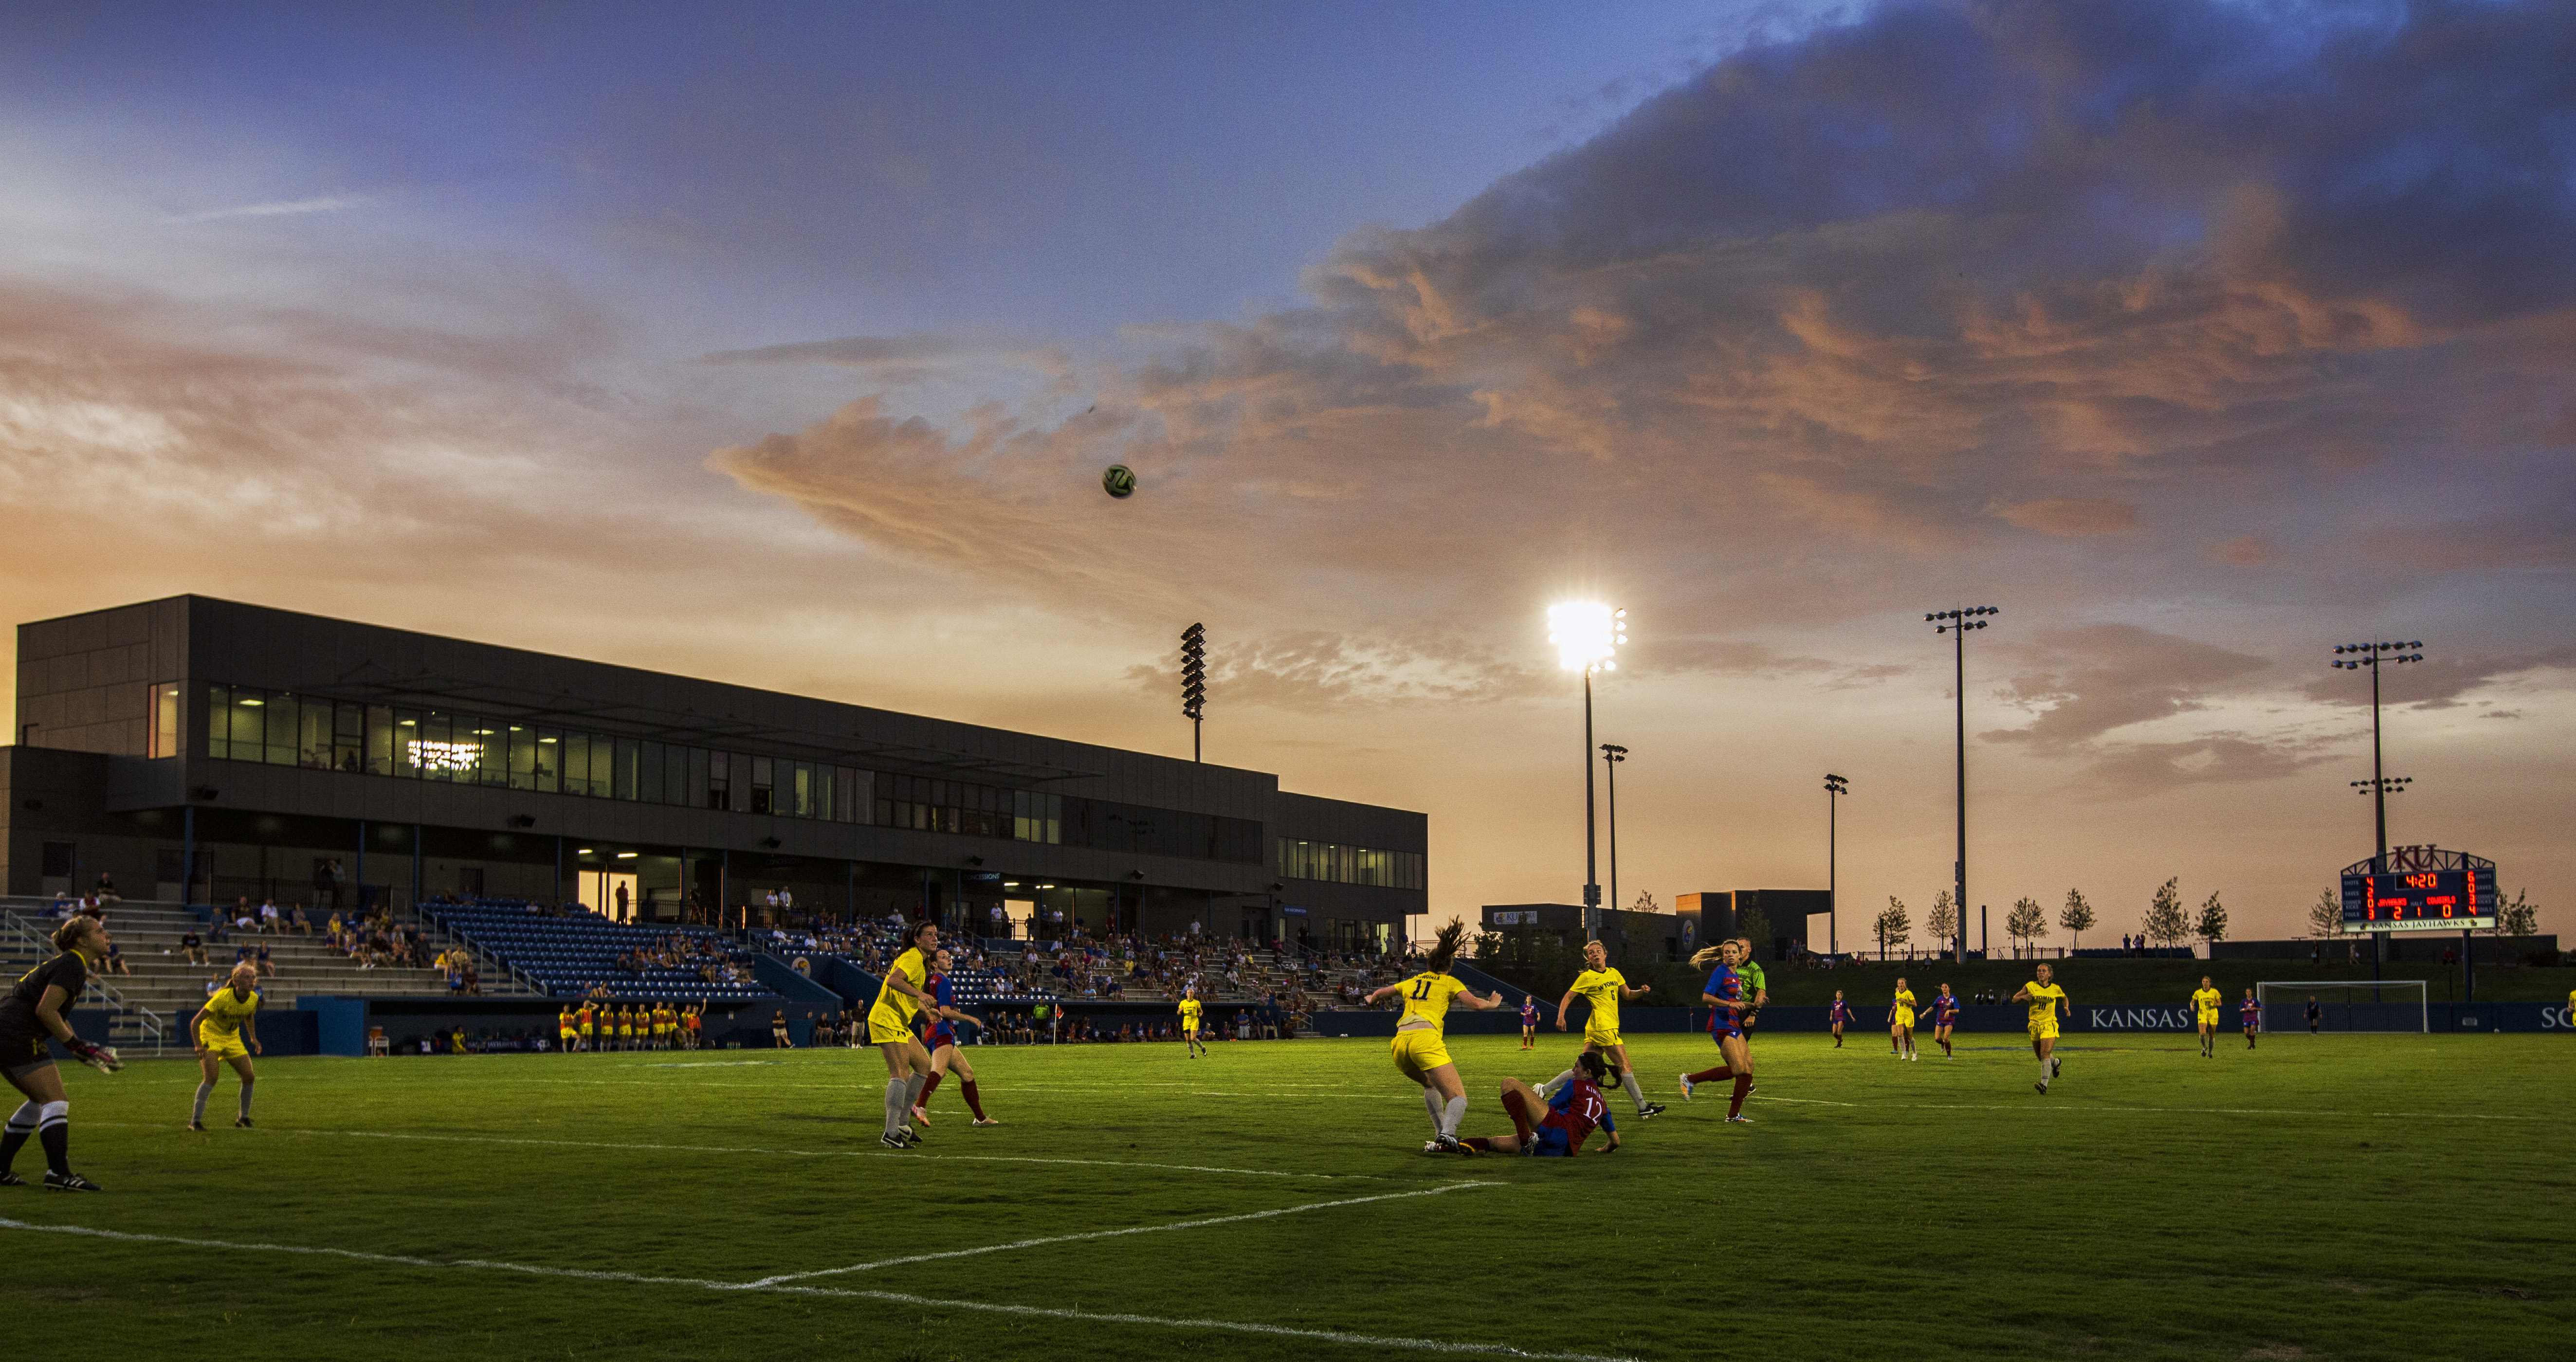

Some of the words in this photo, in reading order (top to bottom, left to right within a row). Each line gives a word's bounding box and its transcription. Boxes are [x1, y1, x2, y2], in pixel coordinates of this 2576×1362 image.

[2393, 844, 2437, 871] KU
[2366, 877, 2374, 887] 4
[2406, 873, 2436, 888] 4:20
[2467, 871, 2475, 883] 6
[2367, 887, 2374, 898] 2
[2468, 882, 2475, 893] 0
[2367, 898, 2374, 908] 0
[2469, 893, 2476, 905] 3
[2368, 908, 2375, 920] 3
[2393, 906, 2402, 920] 2
[2417, 906, 2421, 917] 1
[2443, 904, 2452, 918] 0
[2468, 905, 2476, 916] 4
[1507, 913, 1518, 921] KU
[2412, 920, 2465, 928] JAYHAWKS
[1409, 979, 1432, 1001] 11
[1610, 990, 1616, 1001] 6
[2091, 1008, 2188, 1028] KANSAS
[1583, 1097, 1602, 1125] 12
